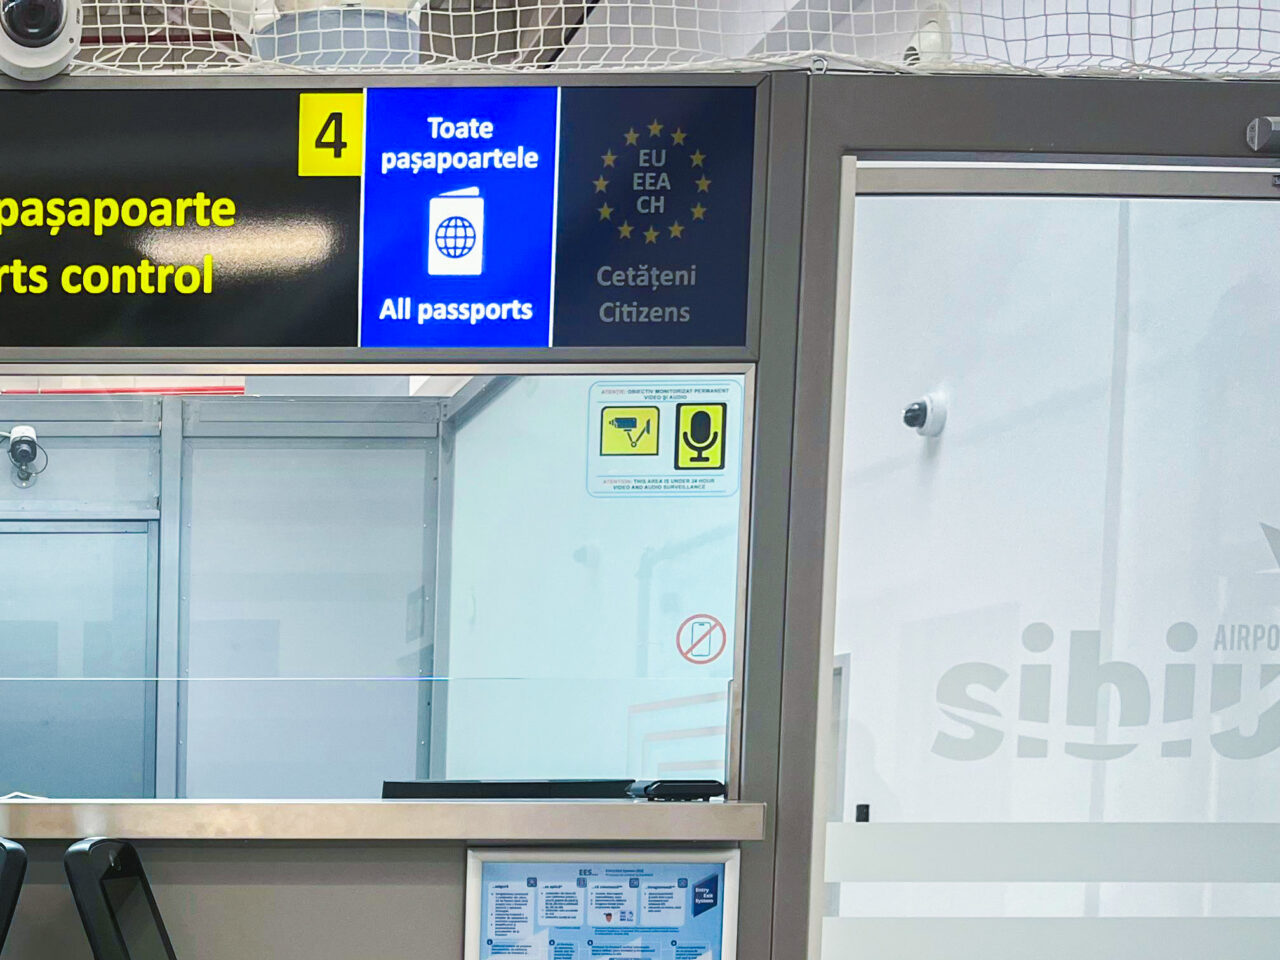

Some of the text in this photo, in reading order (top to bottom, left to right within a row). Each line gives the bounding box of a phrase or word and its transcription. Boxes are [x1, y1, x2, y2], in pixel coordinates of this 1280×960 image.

[314, 111, 348, 159] 4
[426, 116, 494, 140] Toate
[381, 145, 540, 175] pașapoartele
[638, 148, 667, 167] EU
[632, 172, 672, 191] EEA
[636, 195, 665, 214] CH
[61, 254, 214, 294] control
[596, 264, 697, 291] Cetățeni
[378, 296, 534, 326] All passports
[599, 301, 690, 323] Citizens
[1213, 624, 1280, 651] AIRPO
